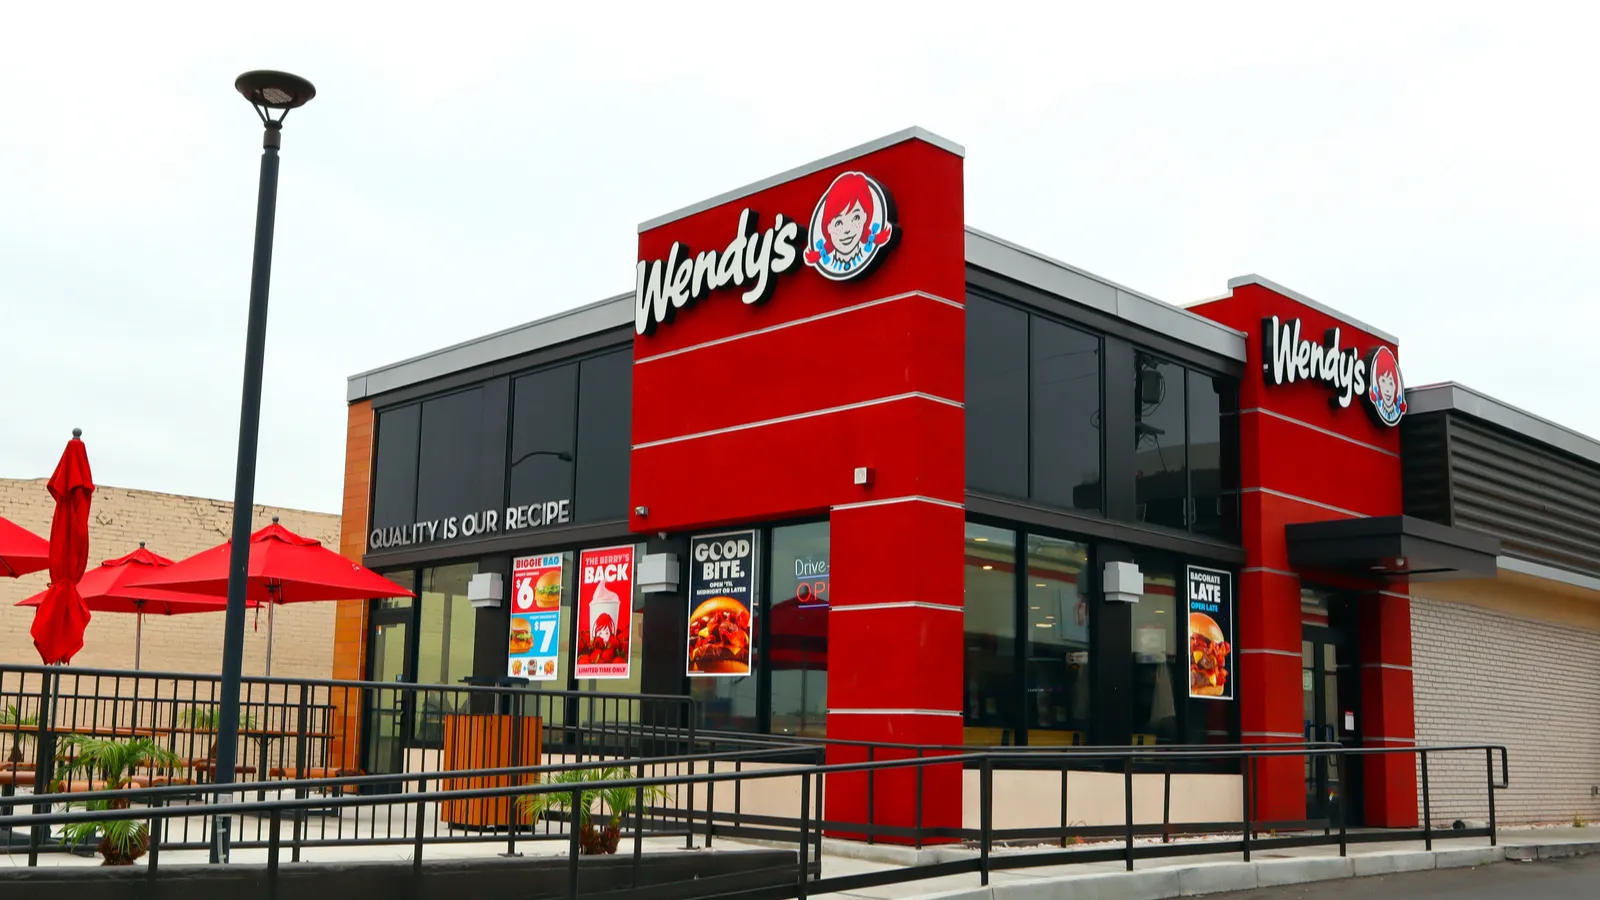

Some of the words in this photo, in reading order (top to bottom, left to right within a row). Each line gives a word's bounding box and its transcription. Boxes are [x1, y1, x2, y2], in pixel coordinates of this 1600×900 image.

[636, 208, 797, 335] Wendy's
[1272, 315, 1365, 408] Wendy's
[370, 520, 439, 549] QUALITY
[443, 516, 458, 539] IS
[462, 510, 498, 537] OUR
[505, 499, 570, 530] RECIPE
[585, 557, 598, 565] THE
[599, 554, 630, 564] BERRY'S
[695, 539, 750, 562] GOOD
[516, 557, 542, 569] BIGGIE
[543, 555, 560, 566] BAG
[703, 560, 745, 580] BITE.
[584, 563, 629, 584] BACK
[1190, 571, 1220, 584] BACONATE
[696, 588, 722, 596] MIDNIGHT
[796, 581, 830, 602] OP
[1191, 581, 1220, 603] LATE
[1191, 602, 1206, 611] OPEN
[1206, 603, 1218, 612] LATE
